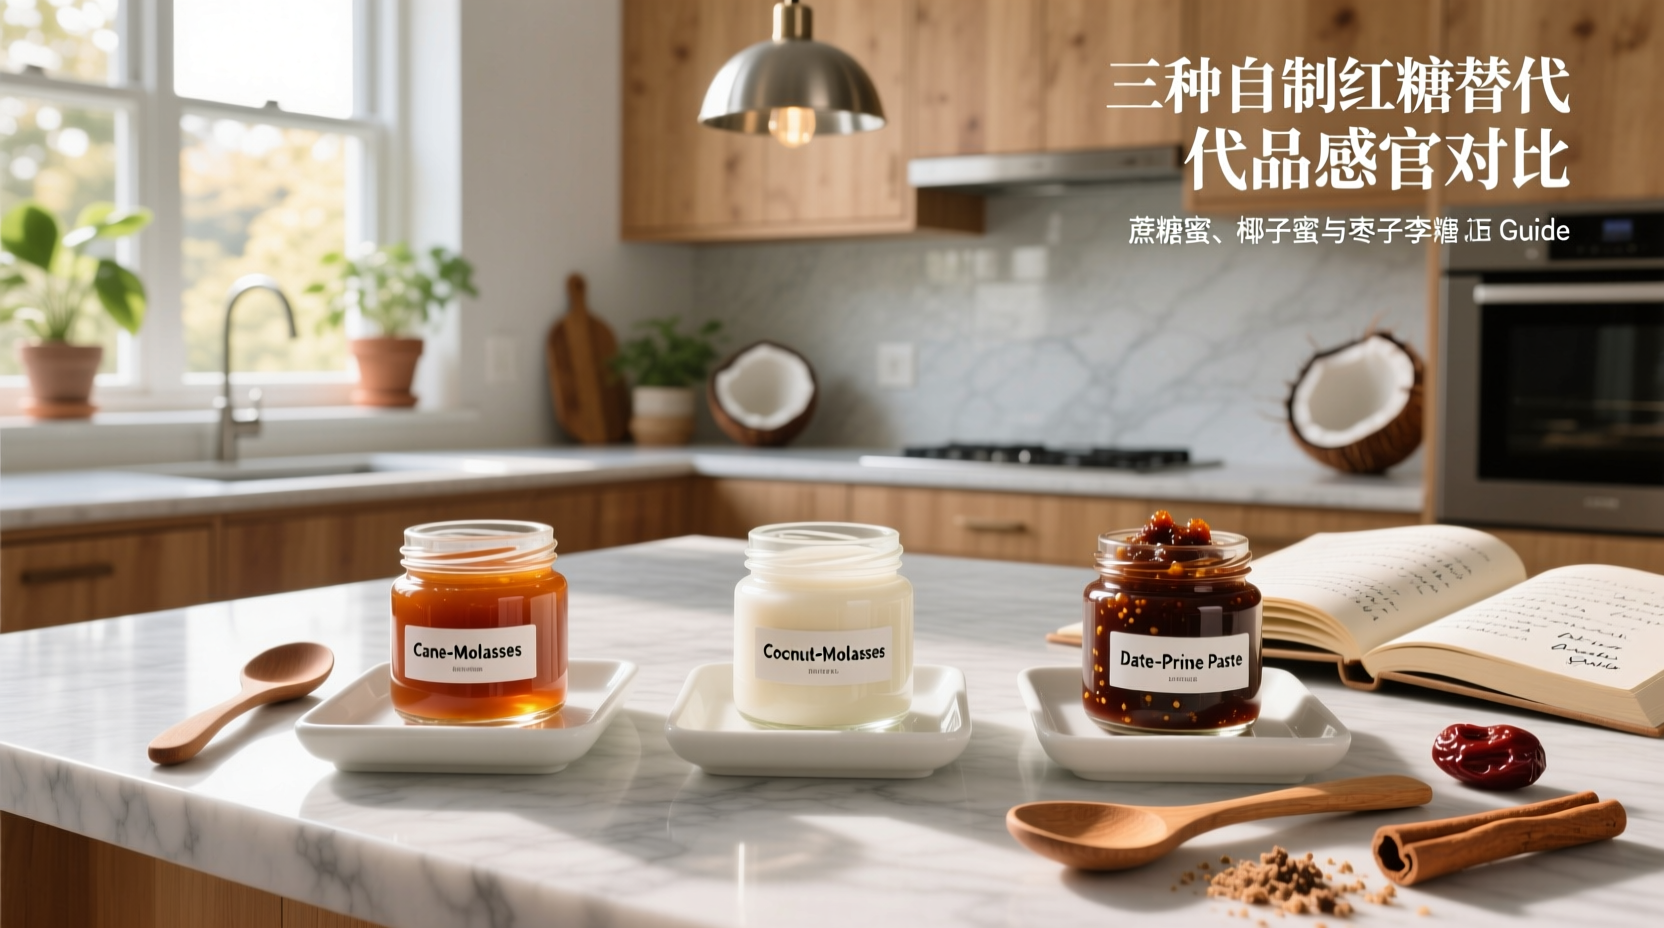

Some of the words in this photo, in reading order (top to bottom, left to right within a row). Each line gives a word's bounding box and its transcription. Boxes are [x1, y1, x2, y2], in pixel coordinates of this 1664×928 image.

[413, 642, 522, 660] Cane-Molasses
[1120, 650, 1204, 671] Date-Prine
[1208, 653, 1243, 669] Paste
